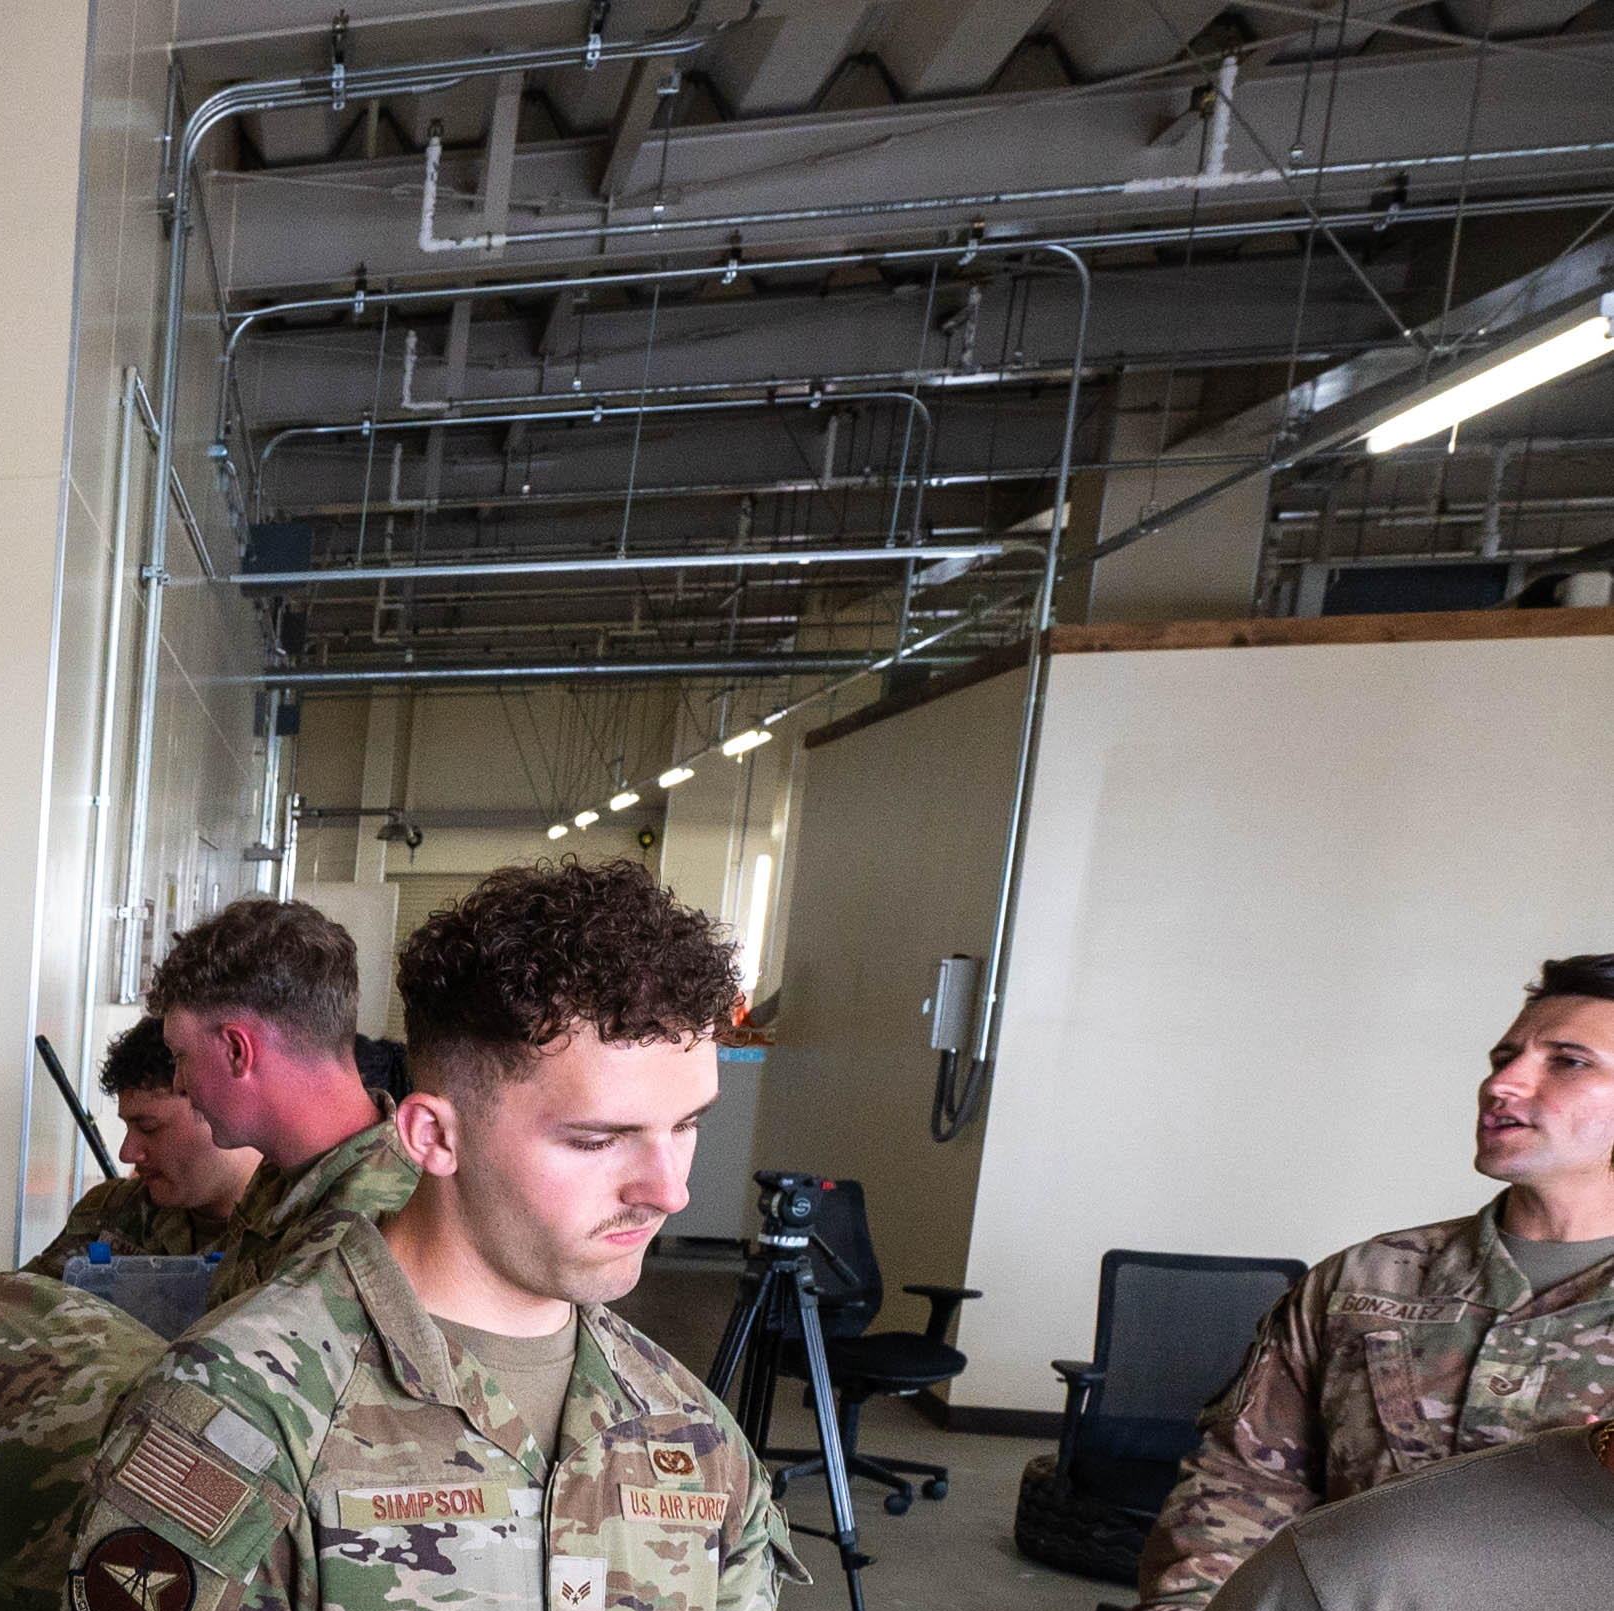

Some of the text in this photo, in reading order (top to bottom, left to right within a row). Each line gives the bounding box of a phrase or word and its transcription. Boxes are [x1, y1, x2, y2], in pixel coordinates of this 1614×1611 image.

[1340, 1295, 1446, 1322] GONZALEZ
[373, 1487, 486, 1521] SIMPSON
[630, 1490, 726, 1522] U.S. AIR FORC
